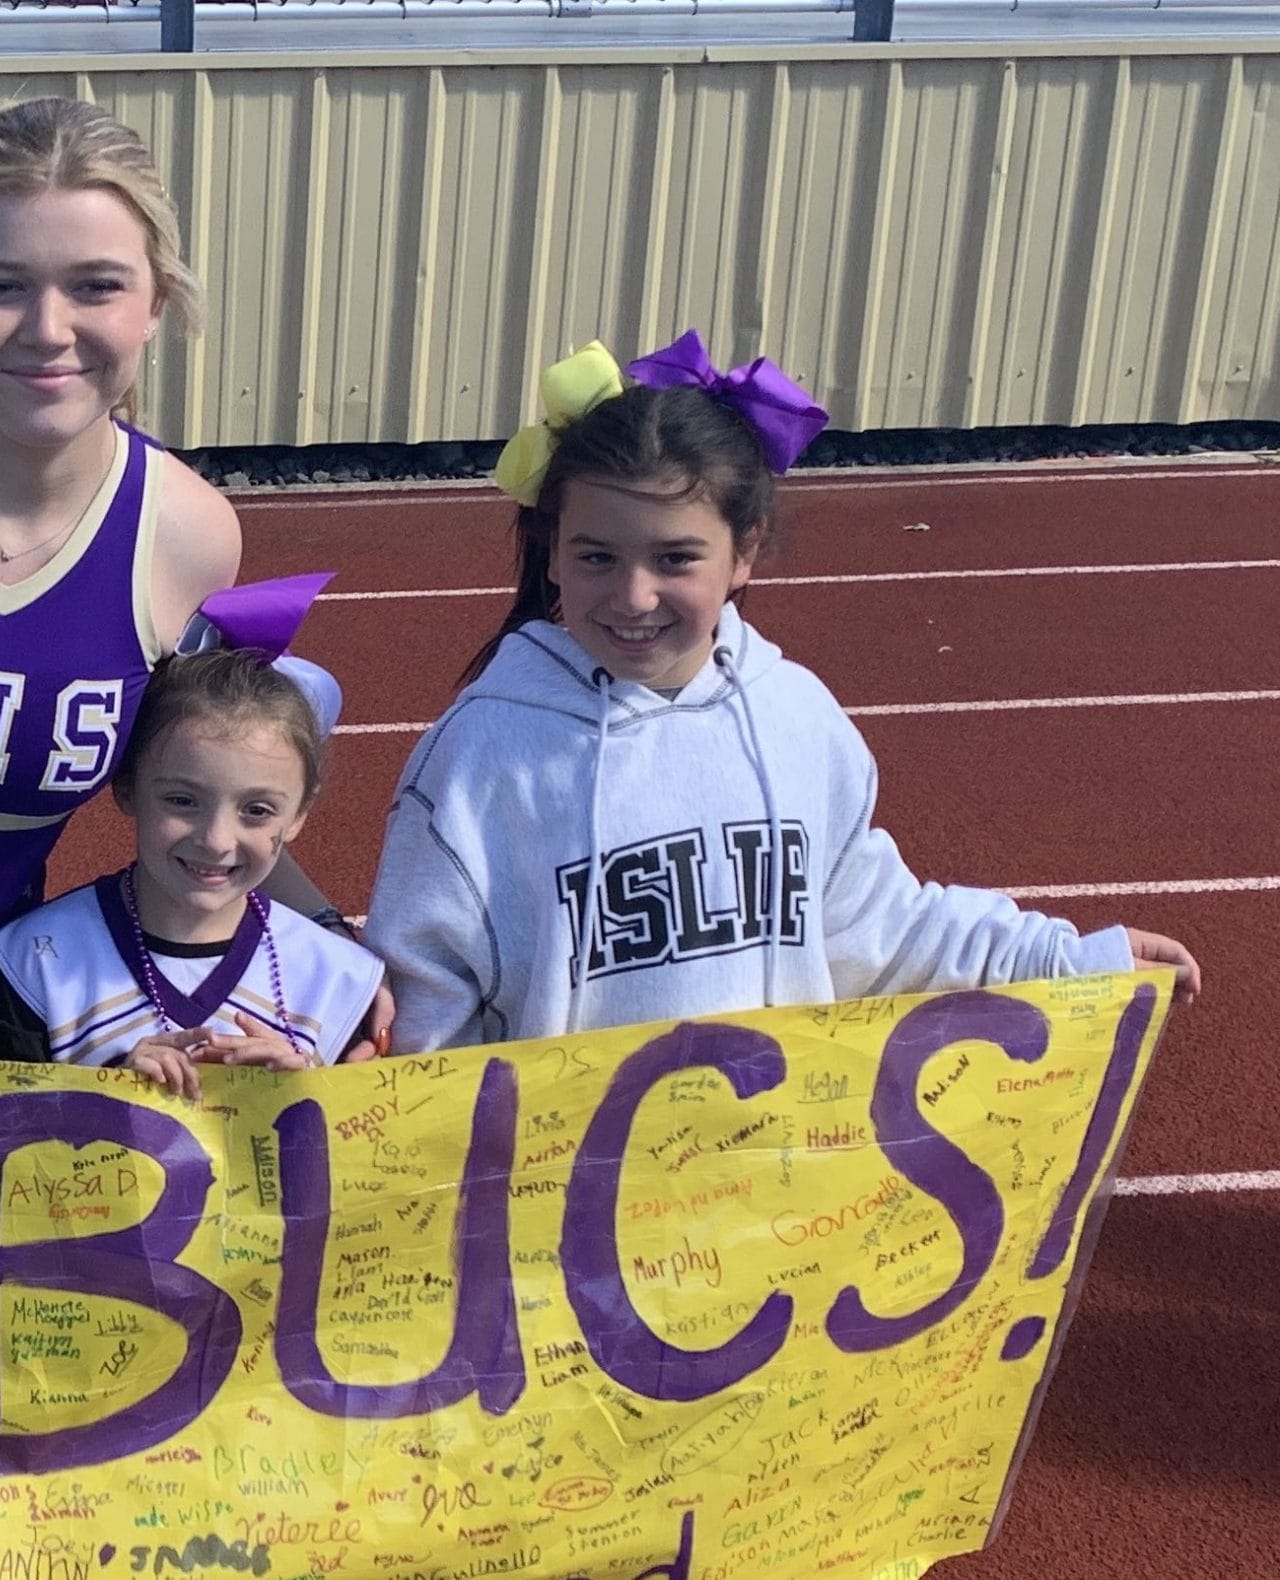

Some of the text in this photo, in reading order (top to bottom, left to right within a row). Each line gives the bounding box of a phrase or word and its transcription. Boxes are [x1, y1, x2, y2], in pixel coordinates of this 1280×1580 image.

[556, 819, 809, 986] ISLIP
[806, 1123, 866, 1148] Haddie
[8, 1169, 104, 1207] Alyssa
[633, 1236, 721, 1288] Murphy
[213, 1444, 370, 1492] Bradley
